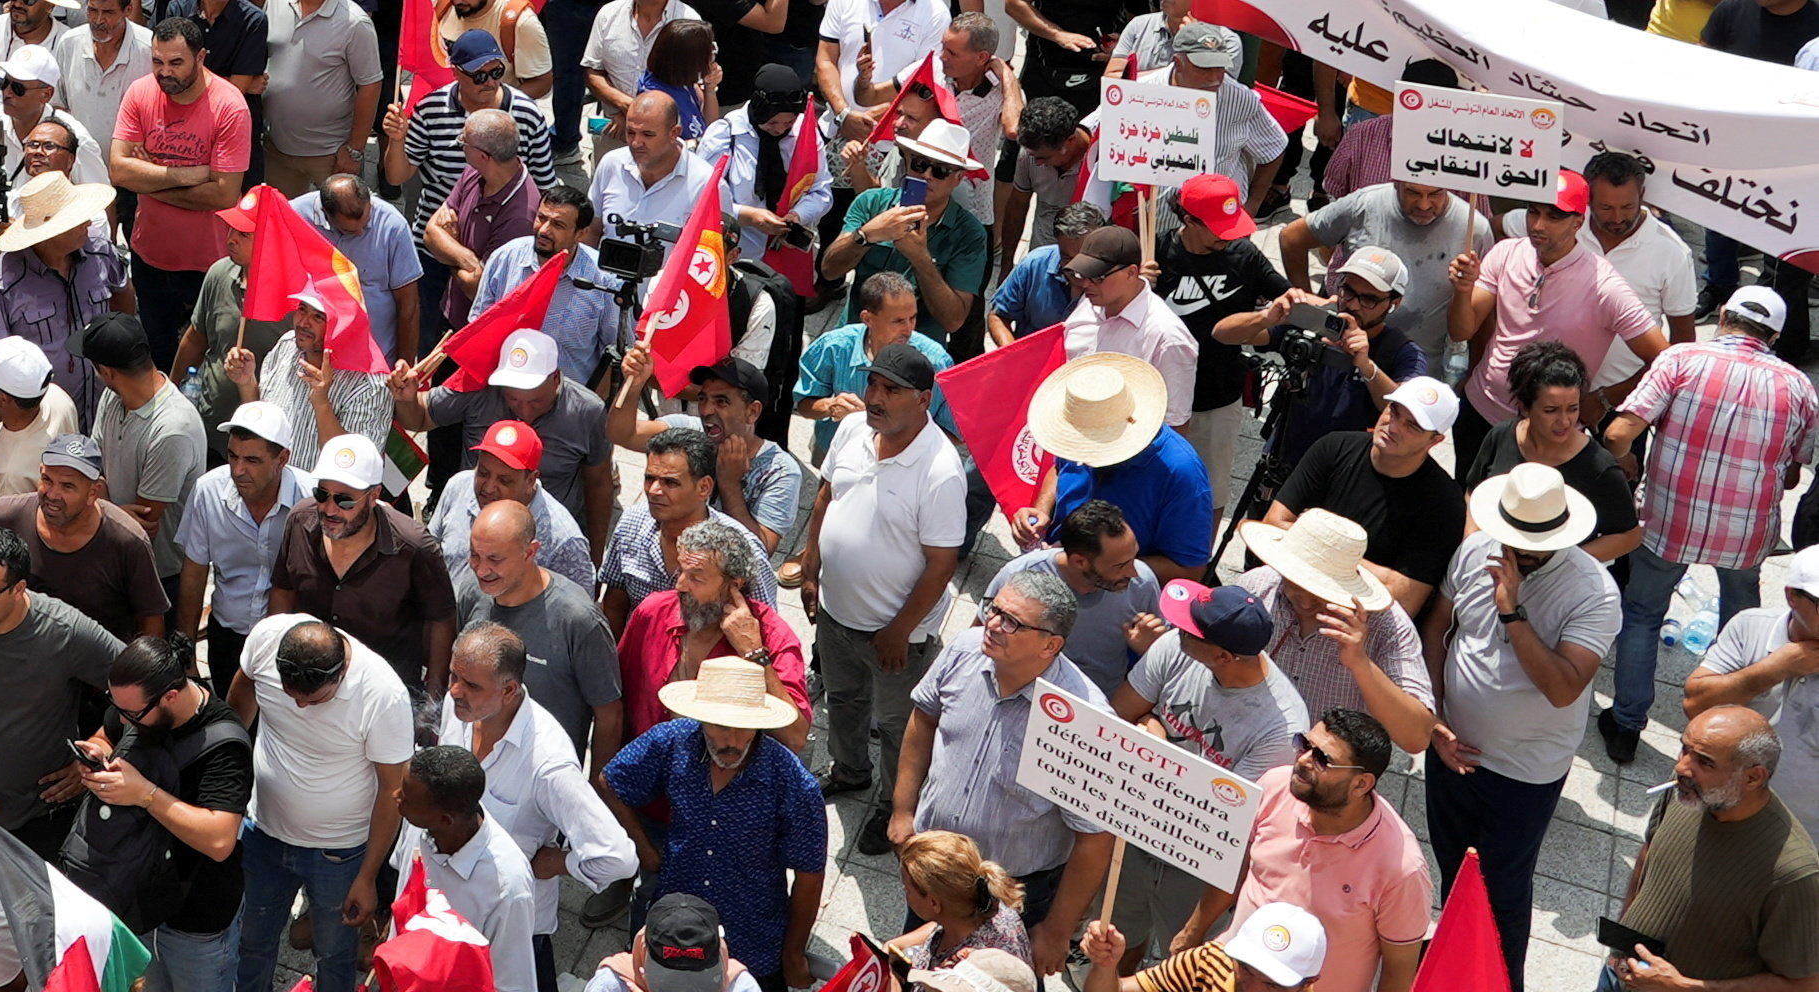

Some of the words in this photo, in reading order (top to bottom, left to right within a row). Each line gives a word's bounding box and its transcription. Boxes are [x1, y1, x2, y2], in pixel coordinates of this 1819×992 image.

[1307, 11, 1390, 63] عليه
[1427, 97, 1452, 110] للشغل
[1453, 102, 1482, 115] التونسي
[1482, 106, 1500, 117] العام
[1501, 109, 1525, 119] الاتحاد
[1163, 125, 1198, 146] فلسطين
[1617, 110, 1711, 146] اتحاد
[1426, 128, 1513, 156] لانتهاك
[1519, 139, 1534, 158] لا
[1127, 146, 1148, 167] على
[1405, 155, 1489, 180] النقابي
[1495, 164, 1548, 189] الحق
[1672, 167, 1800, 236] نختلف
[1175, 274, 1228, 301] NIKE
[1047, 721, 1112, 763] défend
[1118, 759, 1135, 776] et
[1141, 769, 1230, 822] défendra
[1036, 736, 1115, 786] toujours
[1121, 780, 1146, 802] les
[1152, 797, 1211, 834] droits
[1216, 829, 1241, 849] de
[1037, 757, 1077, 786] tous
[1081, 778, 1108, 802] les
[1113, 797, 1225, 862] travailleurs
[1049, 783, 1090, 814] sans
[1096, 804, 1201, 870] distinction
